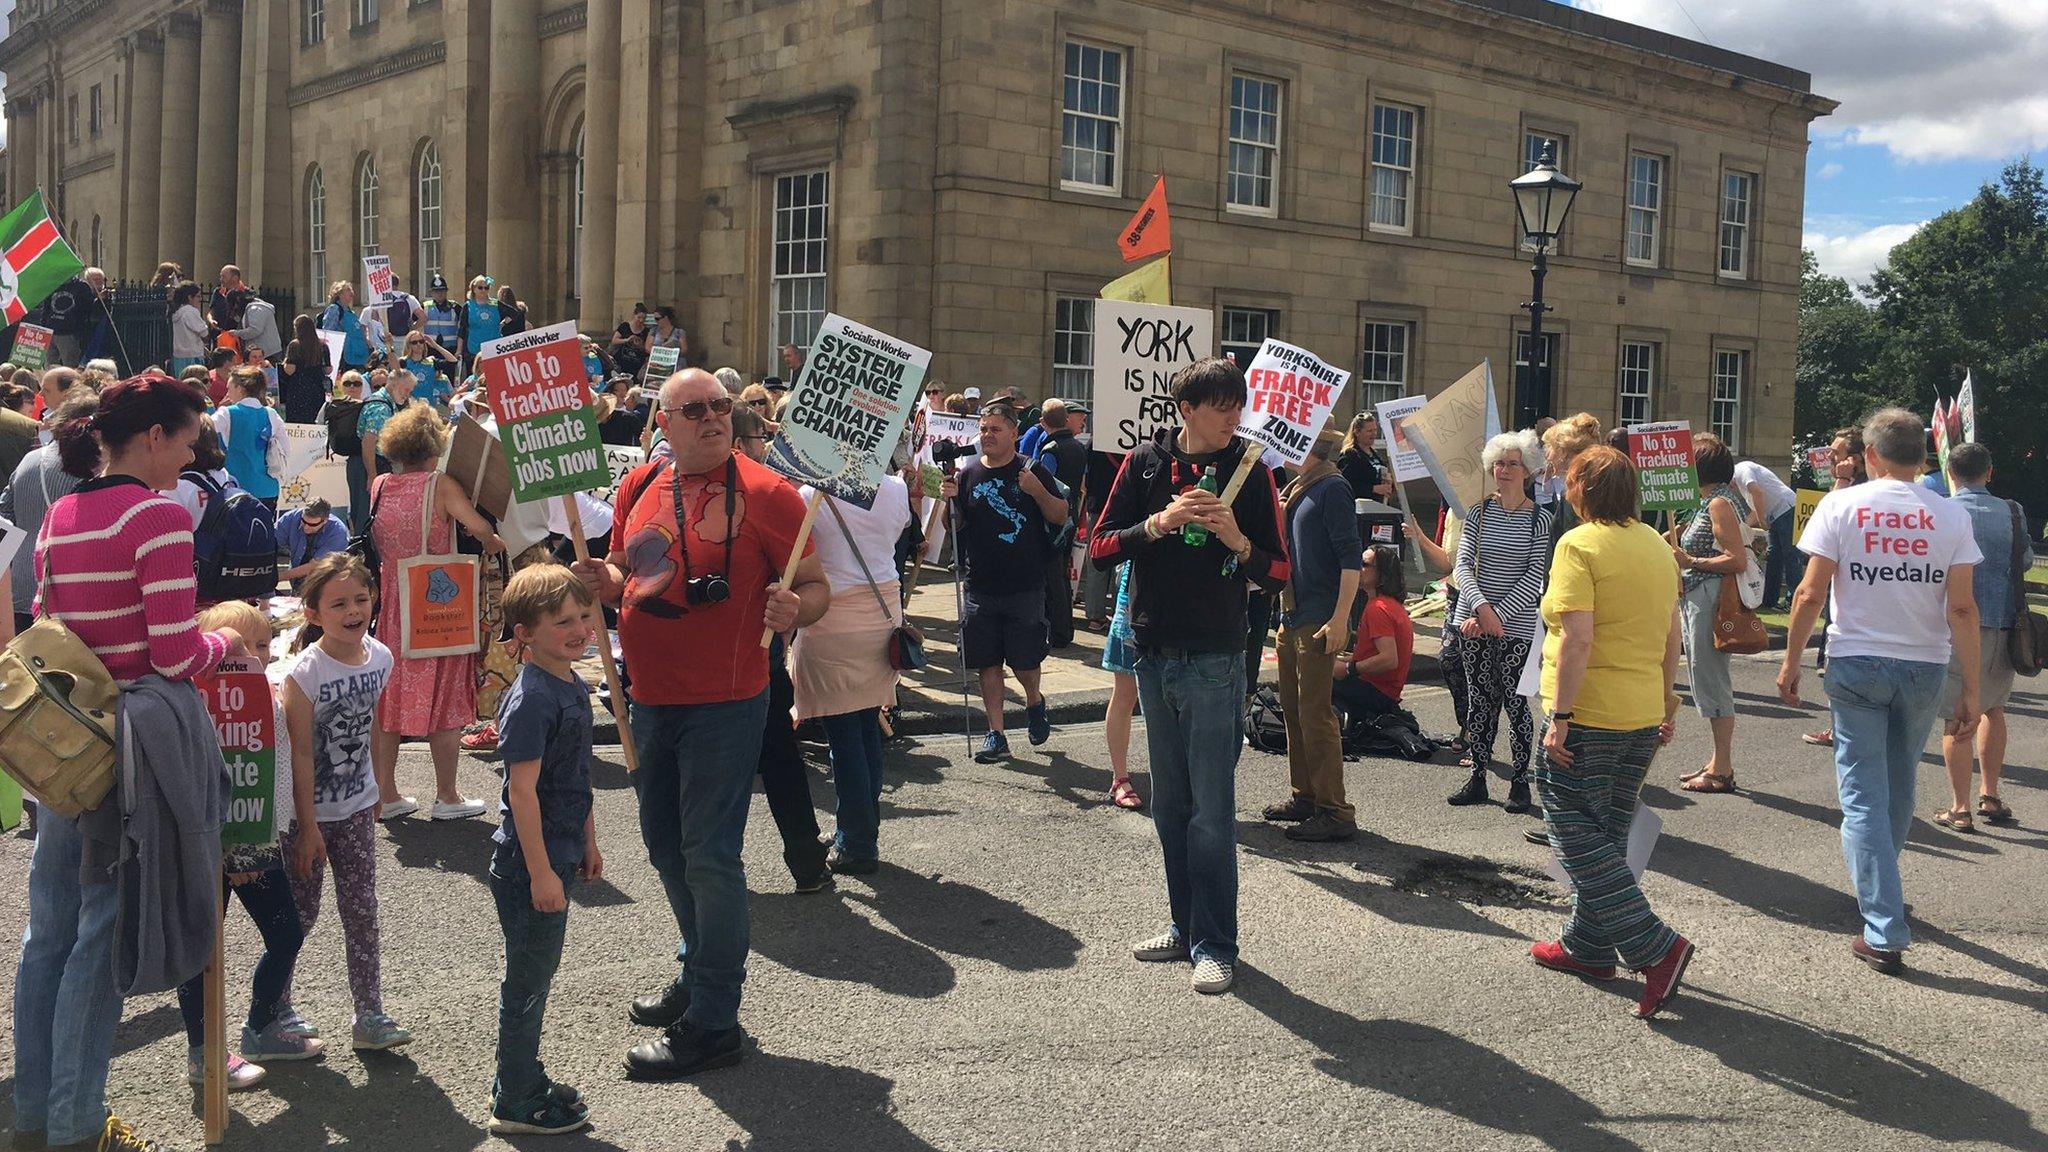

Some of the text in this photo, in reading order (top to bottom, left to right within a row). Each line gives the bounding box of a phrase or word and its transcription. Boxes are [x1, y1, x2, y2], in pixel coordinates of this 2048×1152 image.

[1127, 207, 1155, 246] 38 DEGREES
[1117, 317, 1195, 362] YORK
[504, 351, 560, 387] No to
[820, 334, 905, 382] SYSTEM
[1265, 344, 1343, 386] YORKSHIRE
[1280, 361, 1290, 369] IS
[805, 369, 852, 400] NOT
[852, 388, 868, 399] One
[813, 352, 902, 401] CHANGE
[1125, 368, 1145, 392] IS
[1249, 368, 1332, 407] FRACK
[500, 380, 583, 420] fracking
[798, 388, 889, 439] CLIMATE
[849, 398, 886, 417] revolution
[1139, 397, 1178, 425] FOR
[1252, 391, 1313, 427] FREE
[1385, 406, 1421, 419] GOBSHIT
[286, 429, 328, 439] REE GAS
[512, 415, 587, 453] Climate
[791, 406, 880, 453] CHANGE
[949, 420, 965, 431] NO
[1262, 415, 1312, 452] ZONE
[1642, 434, 1676, 451] No to
[513, 448, 598, 491] jobs now
[1636, 450, 1688, 468] fracking
[1641, 469, 1688, 486] Climate
[1640, 486, 1694, 505] jobs now
[1857, 507, 1935, 530] Frack
[1865, 532, 1928, 556] Free
[1850, 562, 1944, 585] Ryedale
[218, 679, 244, 712] to
[319, 668, 386, 703] STARRY
[215, 713, 263, 752] king
[314, 773, 366, 805] EYES
